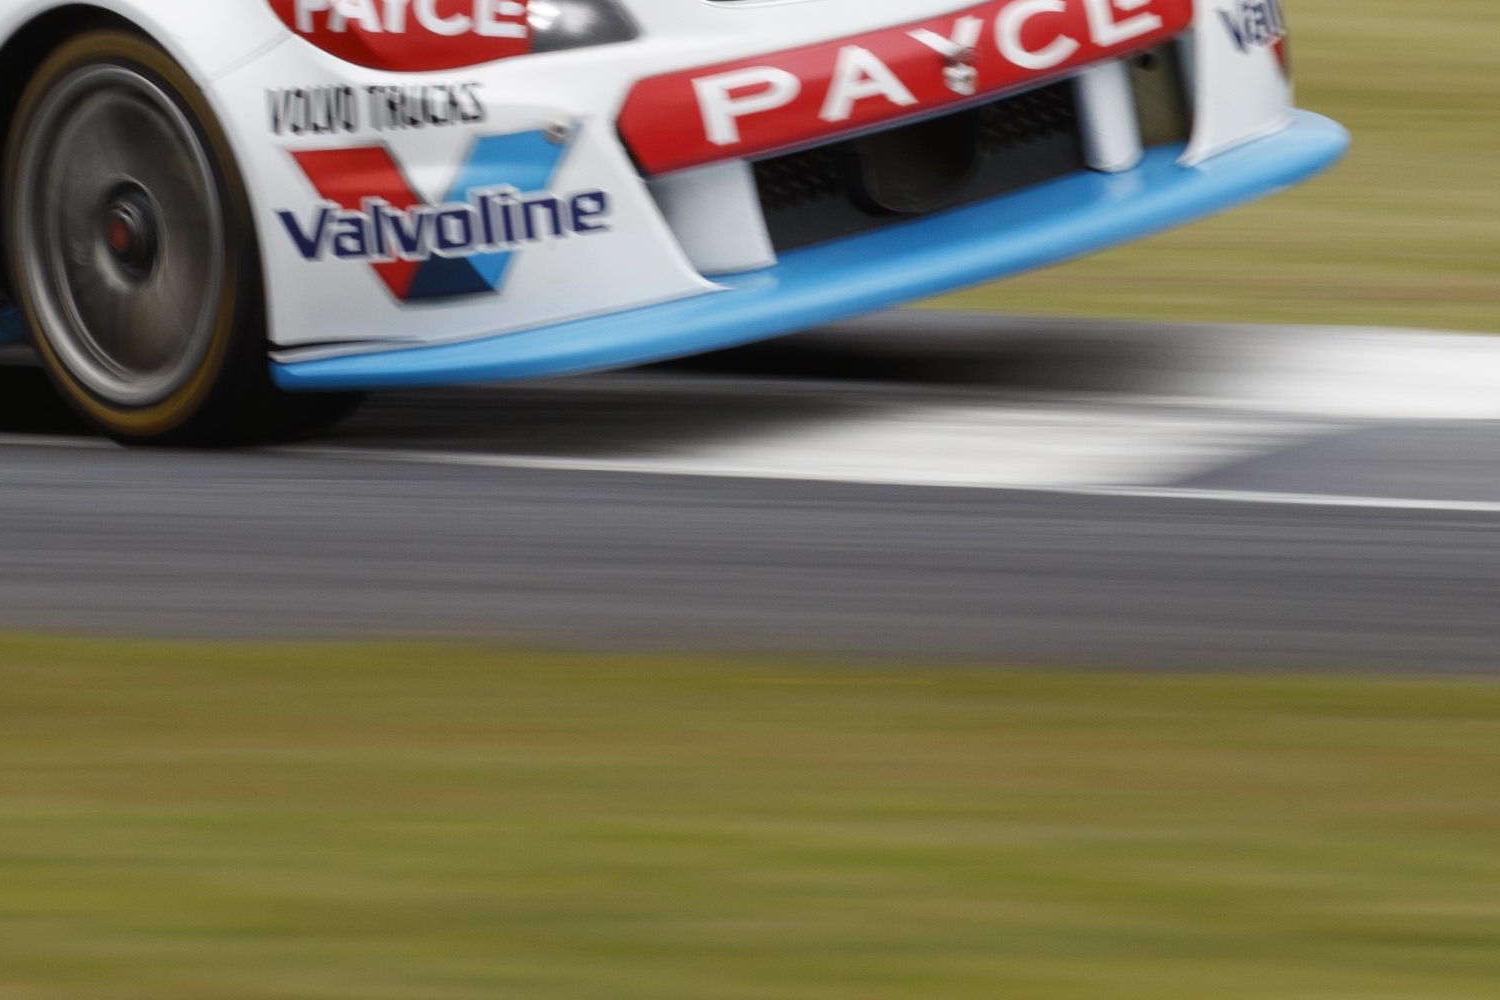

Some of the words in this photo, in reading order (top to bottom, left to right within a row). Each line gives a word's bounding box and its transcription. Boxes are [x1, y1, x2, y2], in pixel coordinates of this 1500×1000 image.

[266, 85, 356, 135] VOLVO
[363, 82, 486, 131] TRUCKS
[275, 190, 610, 261] Valvoline
